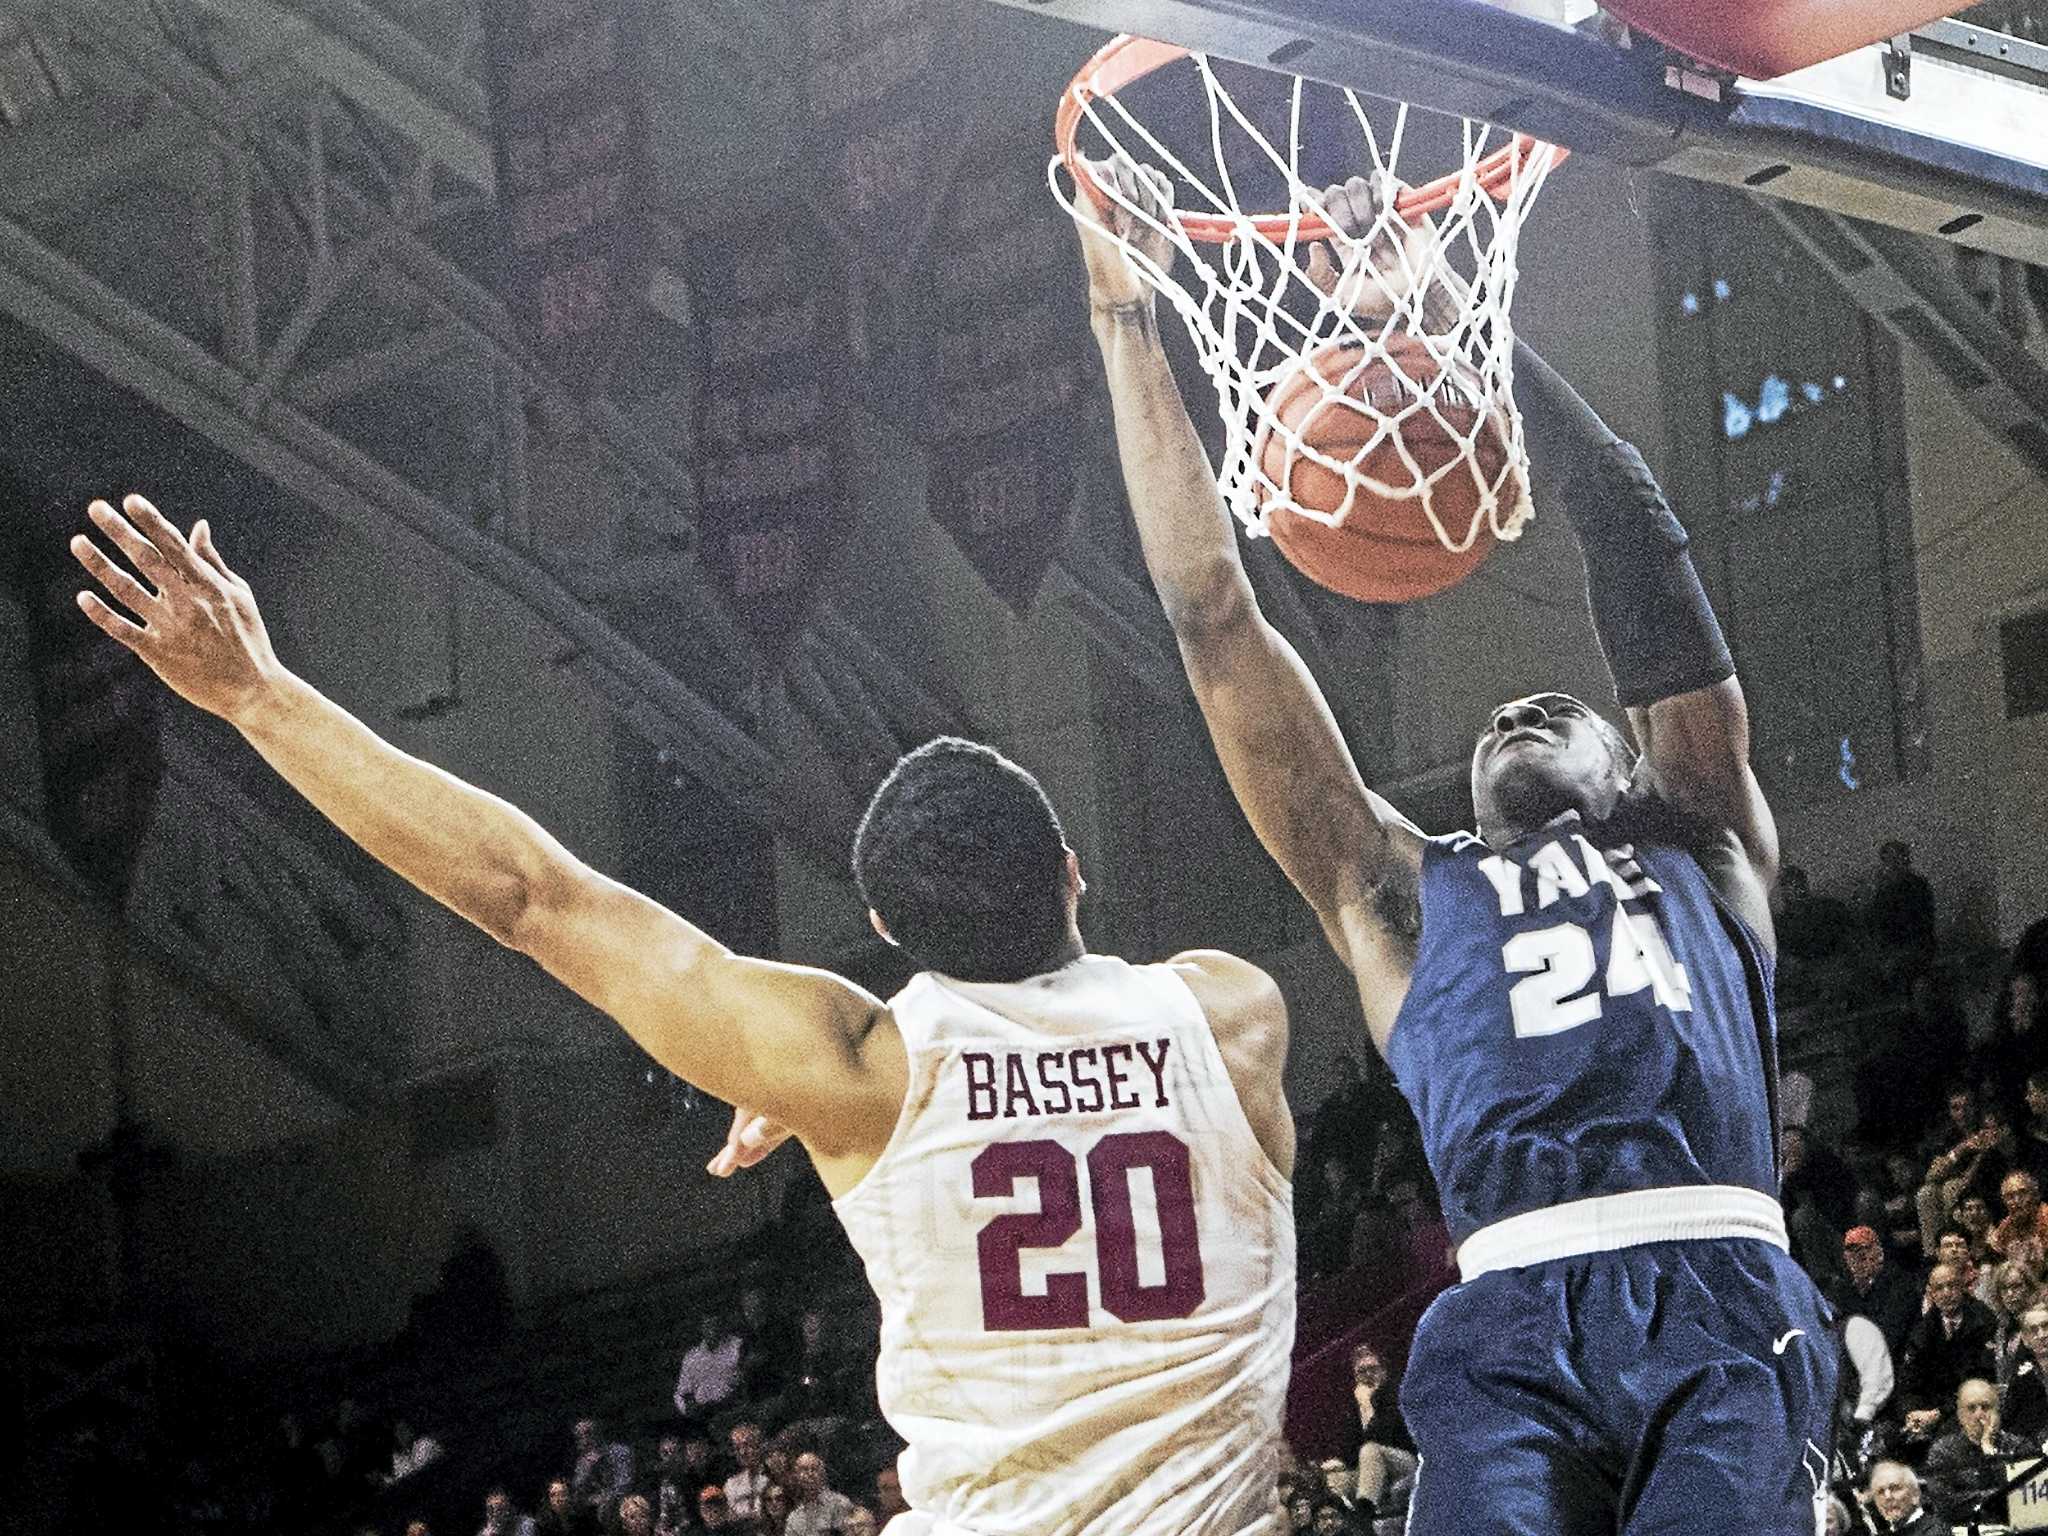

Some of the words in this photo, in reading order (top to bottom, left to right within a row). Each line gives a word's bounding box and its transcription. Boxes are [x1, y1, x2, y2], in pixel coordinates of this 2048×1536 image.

[1502, 900, 1692, 1039] 24
[961, 1038, 1170, 1121] BASSEY
[971, 1130, 1206, 1331] 20
